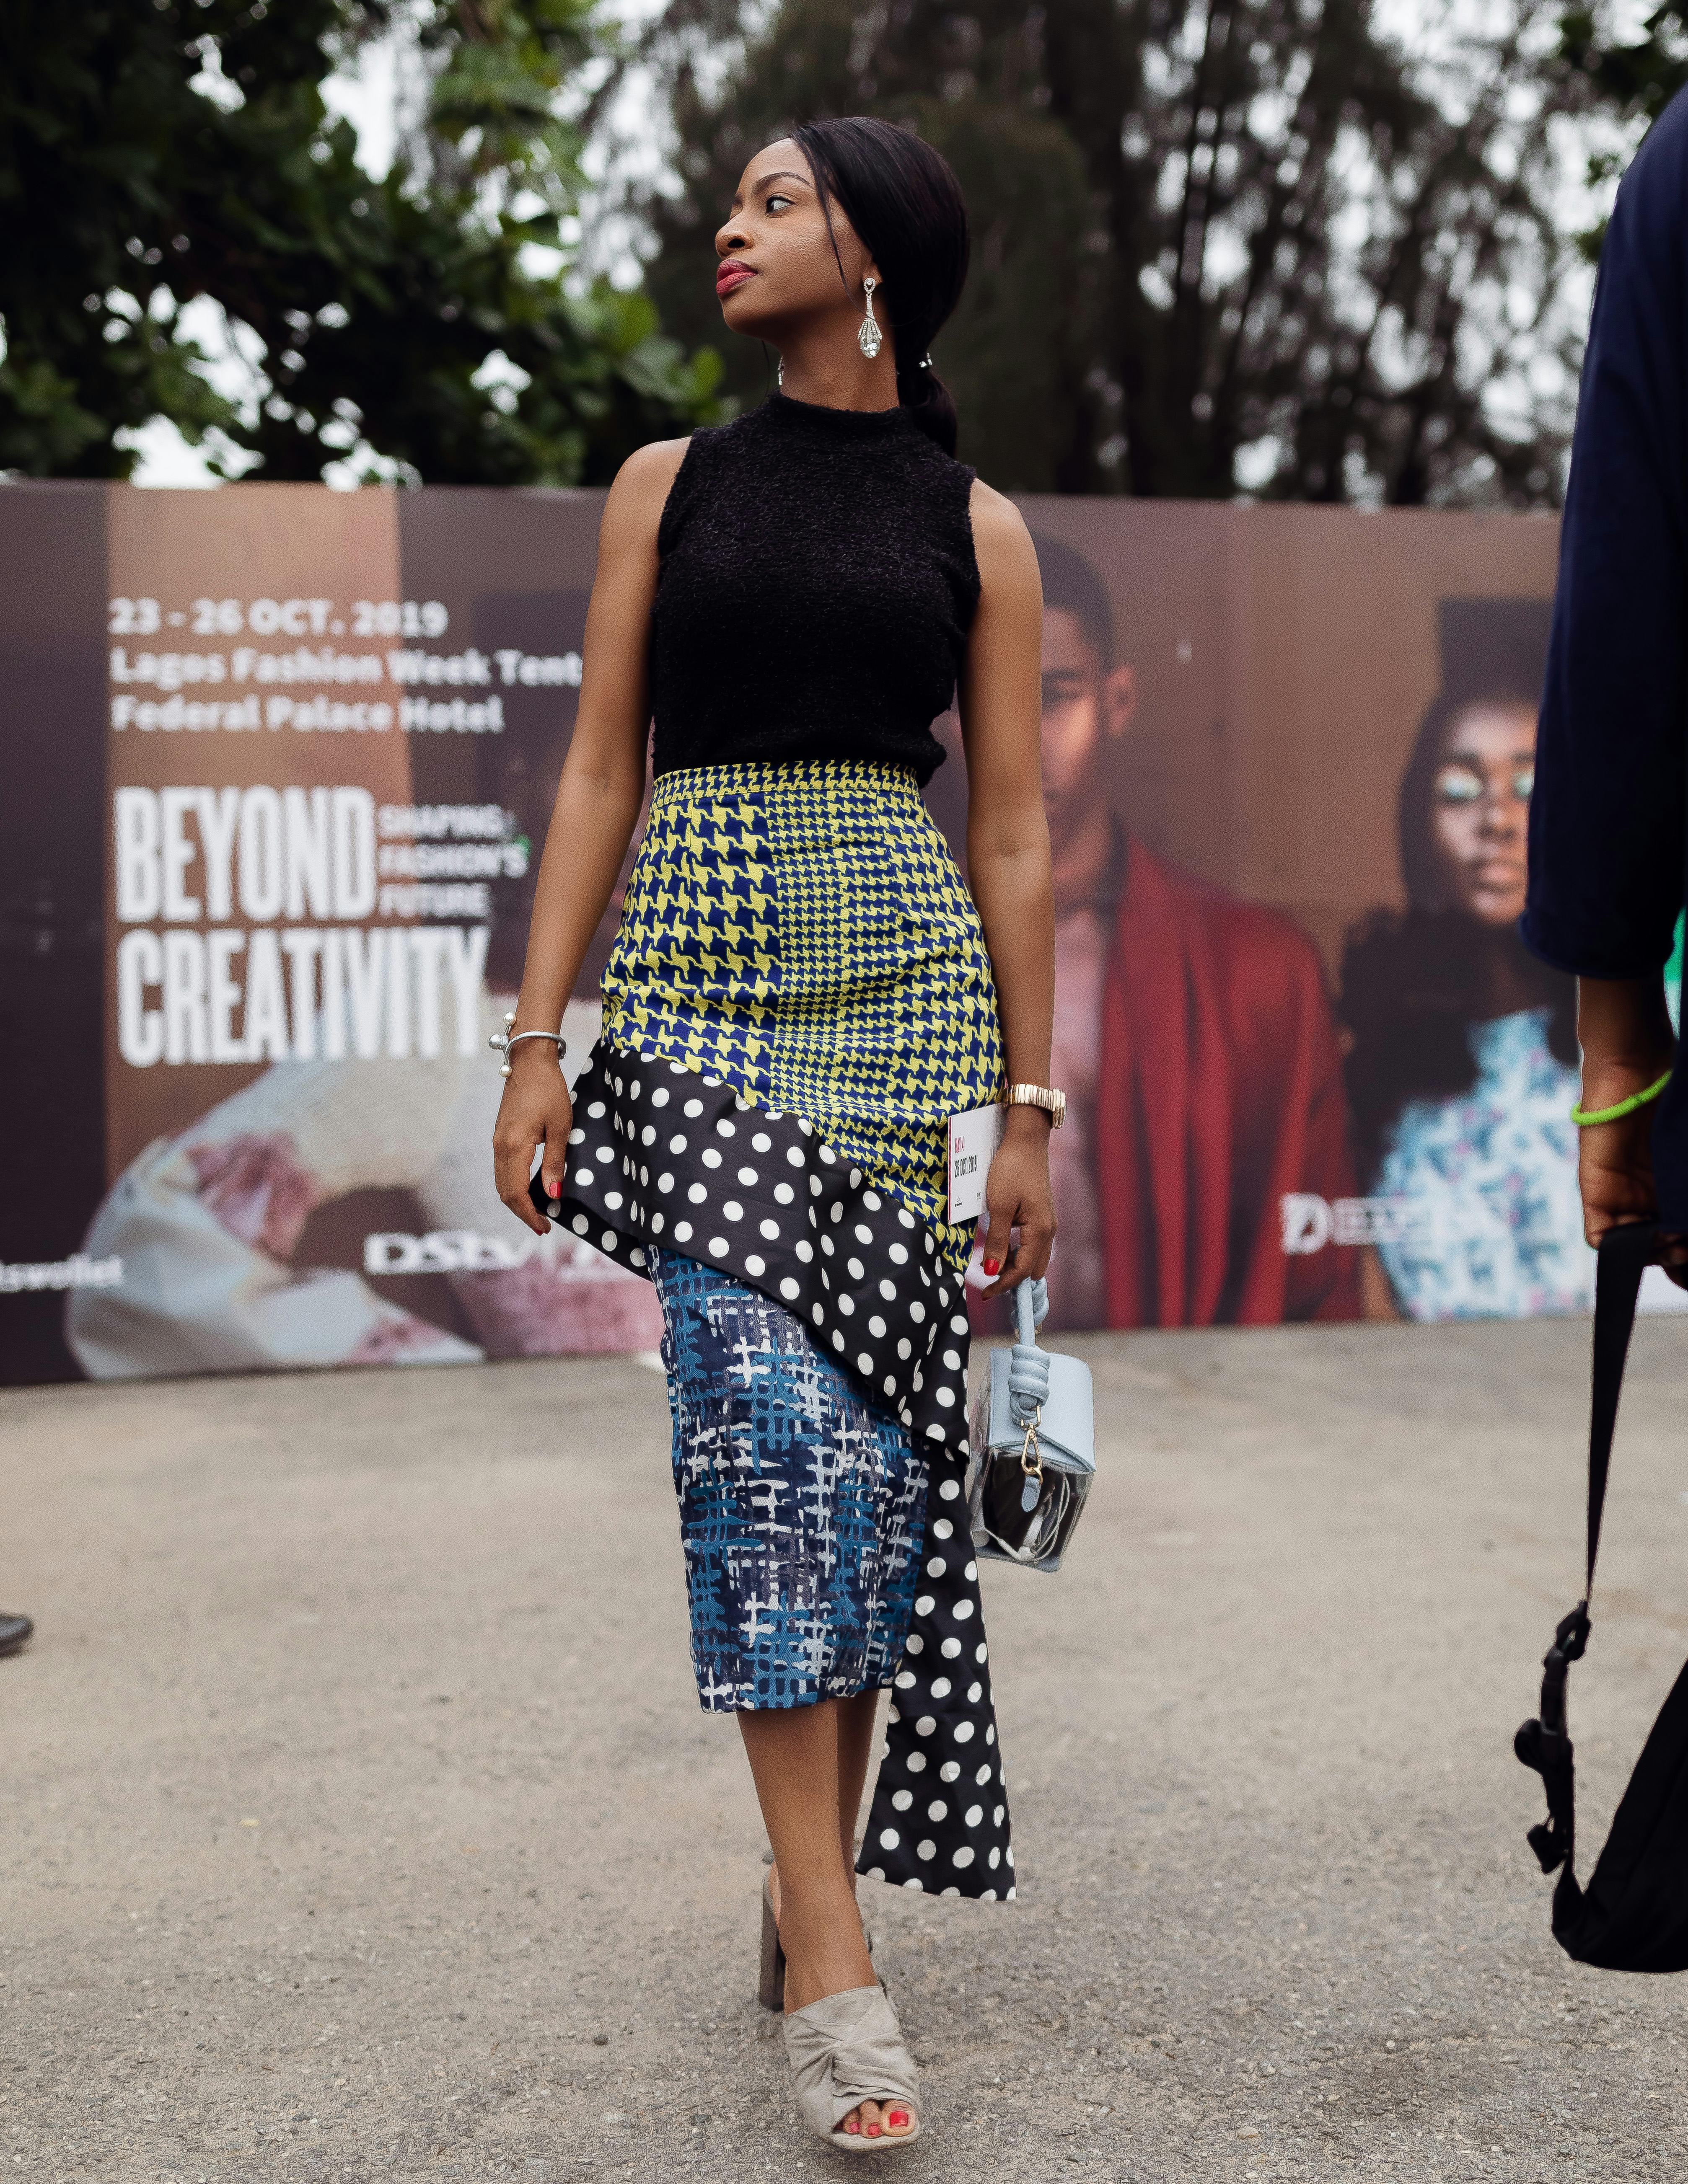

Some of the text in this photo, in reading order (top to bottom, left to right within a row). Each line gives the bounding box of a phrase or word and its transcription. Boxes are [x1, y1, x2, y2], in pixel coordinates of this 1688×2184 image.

[110, 598, 161, 635] 23
[191, 598, 243, 636] 26
[352, 600, 448, 638] 2019
[110, 647, 226, 690] Lagos
[231, 647, 382, 684] Fashion
[387, 648, 492, 685] Week
[110, 695, 504, 734] Federal Palace Hotel
[377, 804, 506, 839] SHAPING
[114, 785, 375, 922] BEYOND
[378, 882, 491, 919] FUTURE
[117, 925, 491, 1067] CREATIVITY
